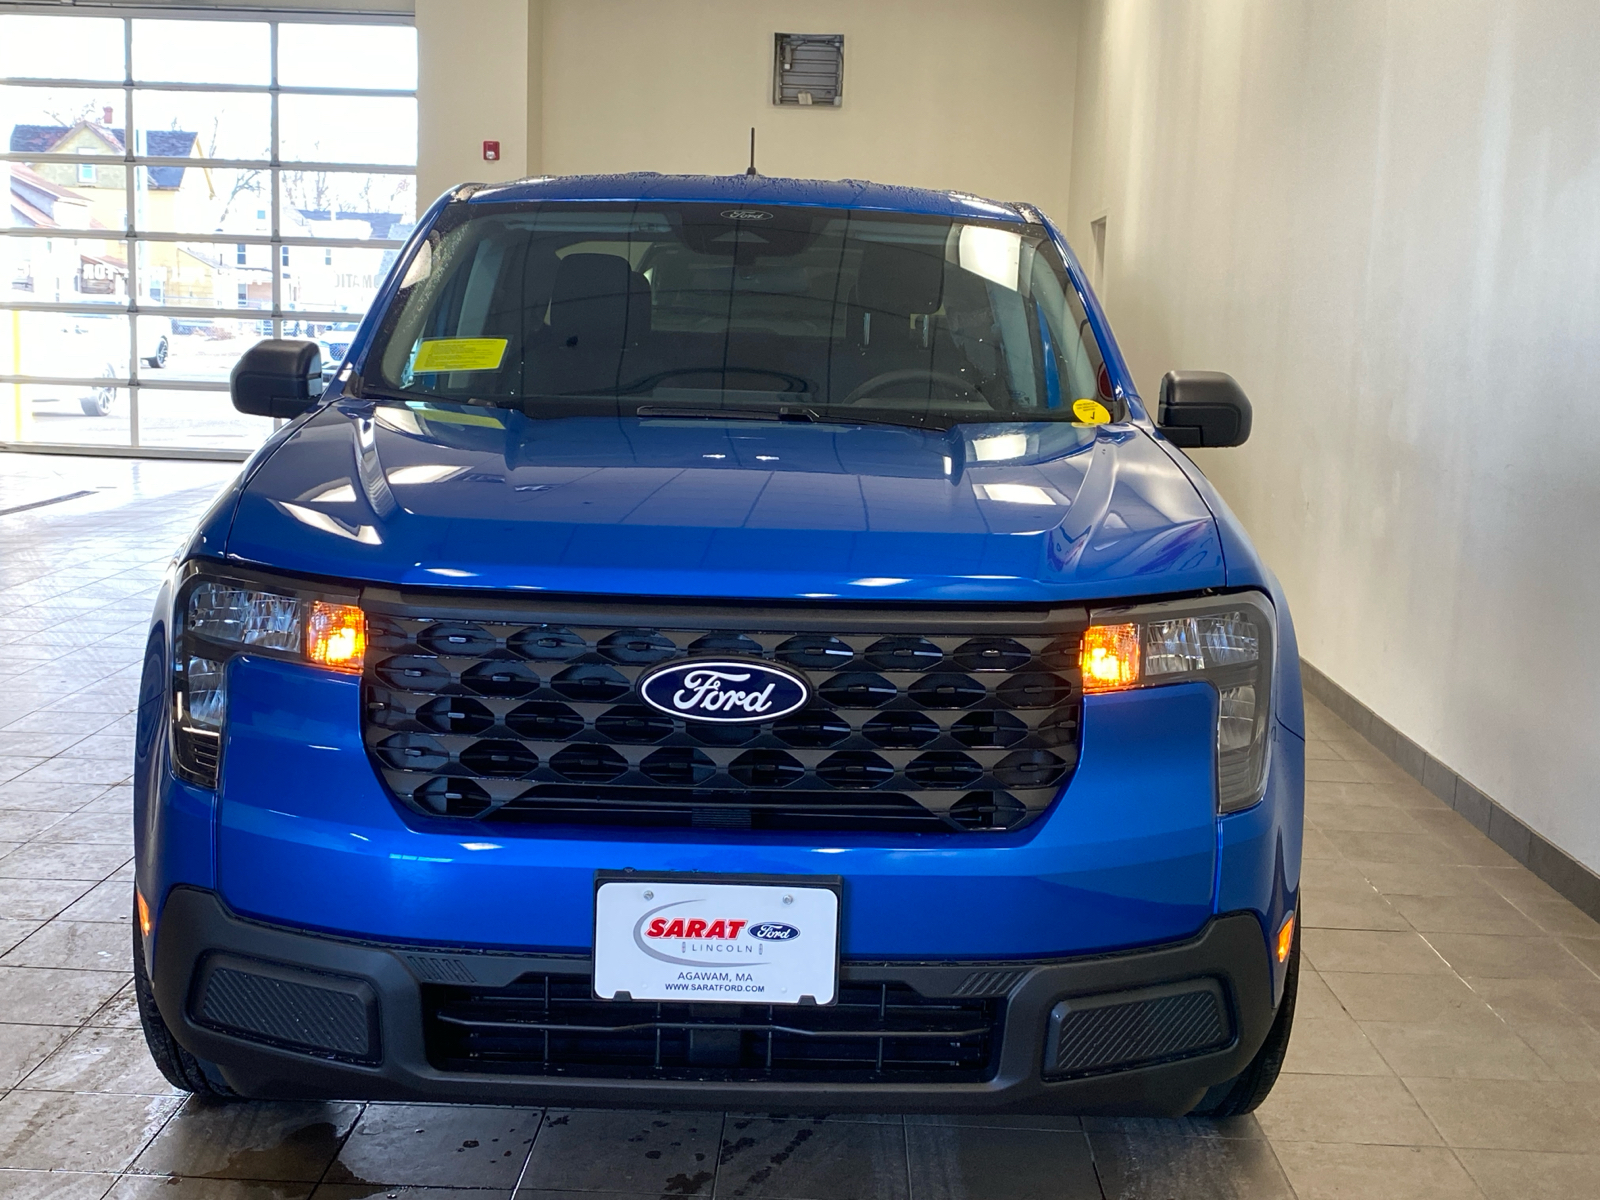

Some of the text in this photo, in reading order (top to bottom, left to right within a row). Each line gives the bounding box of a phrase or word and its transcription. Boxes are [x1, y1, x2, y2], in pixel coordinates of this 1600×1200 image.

[729, 210, 764, 219] Ford
[673, 670, 776, 712] Ford
[645, 917, 791, 940] SARAT Ford
[692, 943, 753, 953] LINCOLN
[677, 971, 753, 983] AGAWAM, MA
[665, 983, 765, 993] WWW.SARATFORD.COM
